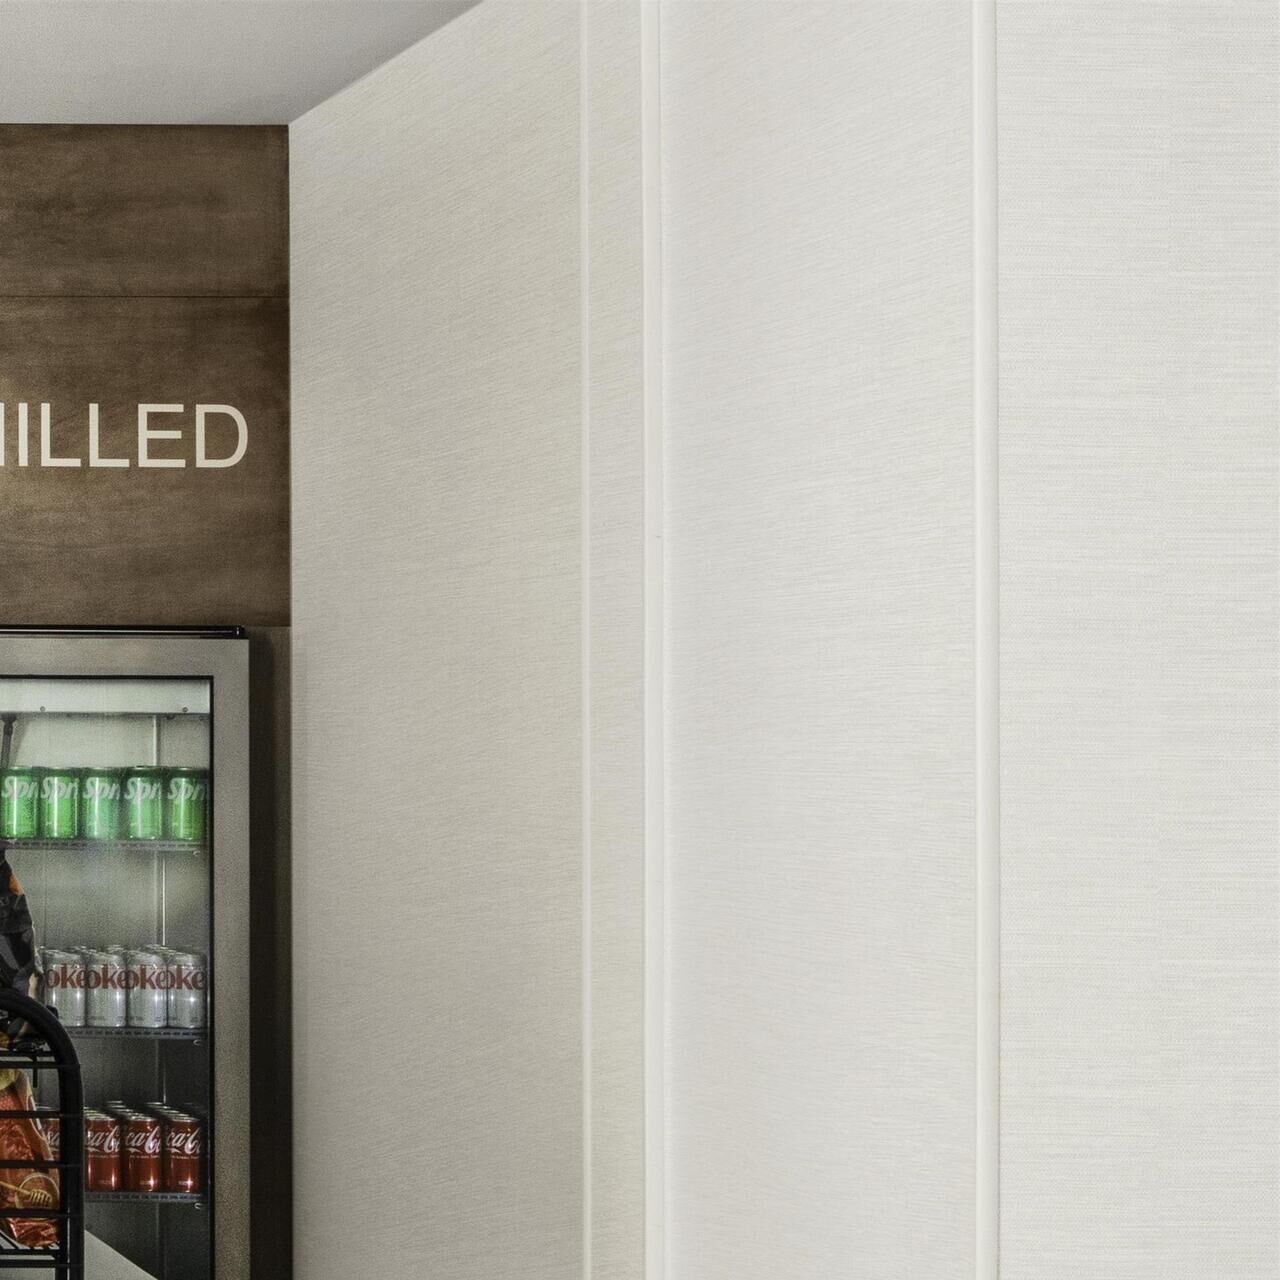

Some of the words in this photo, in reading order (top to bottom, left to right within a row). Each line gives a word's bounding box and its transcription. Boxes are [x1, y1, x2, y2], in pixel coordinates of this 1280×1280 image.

[46, 964, 86, 990] oke
[87, 964, 126, 990] oke
[127, 964, 166, 990] oke
[168, 964, 206, 990] oke
